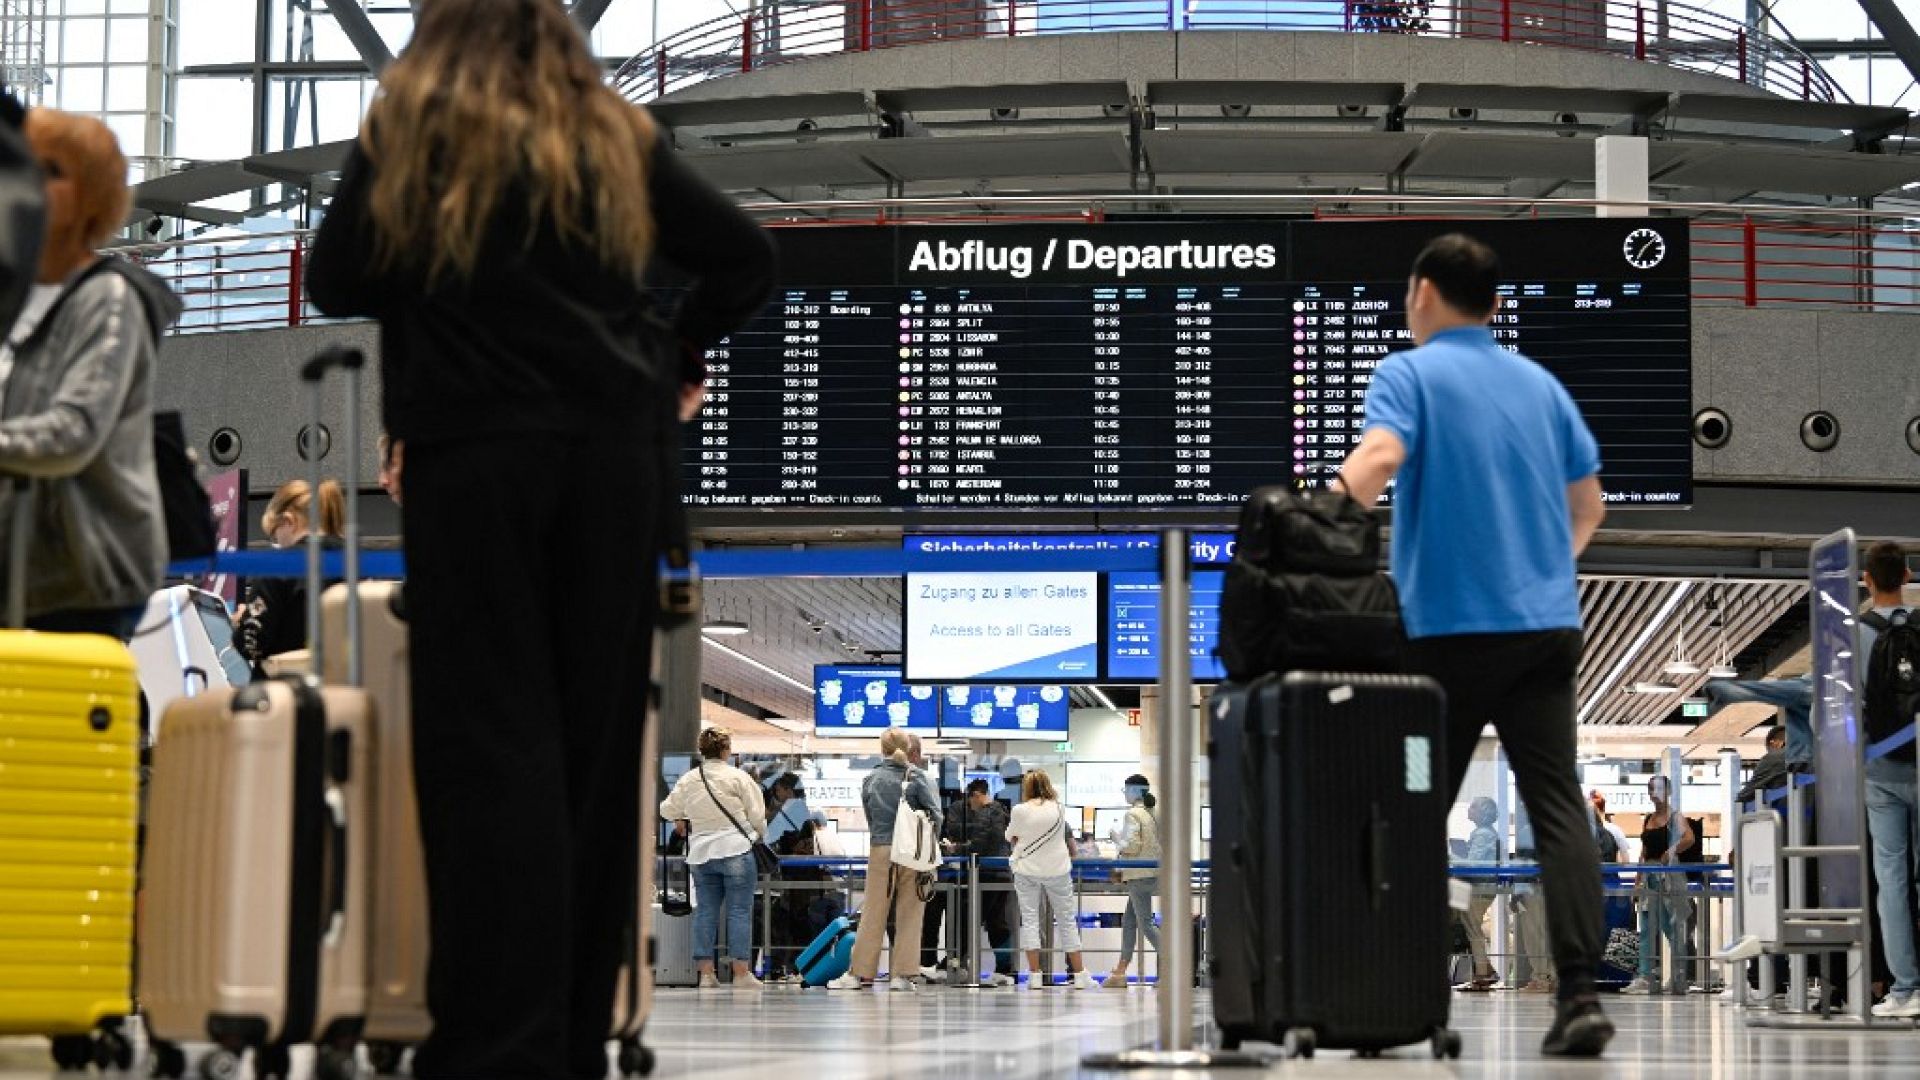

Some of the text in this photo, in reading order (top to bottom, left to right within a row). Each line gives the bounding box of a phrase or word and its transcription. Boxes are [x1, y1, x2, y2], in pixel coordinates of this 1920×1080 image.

[909, 238, 1276, 278] Abflug / Departures
[830, 305, 871, 316] Boarding
[1352, 302, 1388, 310] ZUERICH
[957, 319, 983, 327] SPLIT
[1353, 315, 1378, 325] TIVAT
[957, 334, 998, 342] LISSABON
[1352, 330, 1378, 339] PALMA
[1382, 330, 1393, 339] DE
[1352, 345, 1388, 354] ANTALYA
[956, 377, 997, 386] VALENCIA
[956, 392, 992, 400] ANTALYA
[956, 420, 1001, 430] FRANKFURT
[956, 436, 981, 445] PALMA
[986, 436, 996, 445] DE
[1000, 435, 1041, 445] MALLORCA
[958, 450, 995, 459] ISTANBUL
[956, 480, 1001, 488] AMSTERDAM
[810, 494, 849, 503] Check-in
[917, 494, 956, 503] Schalter
[1005, 494, 1040, 503] Stunden
[1063, 494, 1095, 504] Abflug
[1098, 494, 1133, 503] bekannt
[1196, 493, 1238, 502] Check-in
[920, 584, 1088, 602] Zugang zu allen Gates
[930, 623, 1072, 636] Access to all Gates
